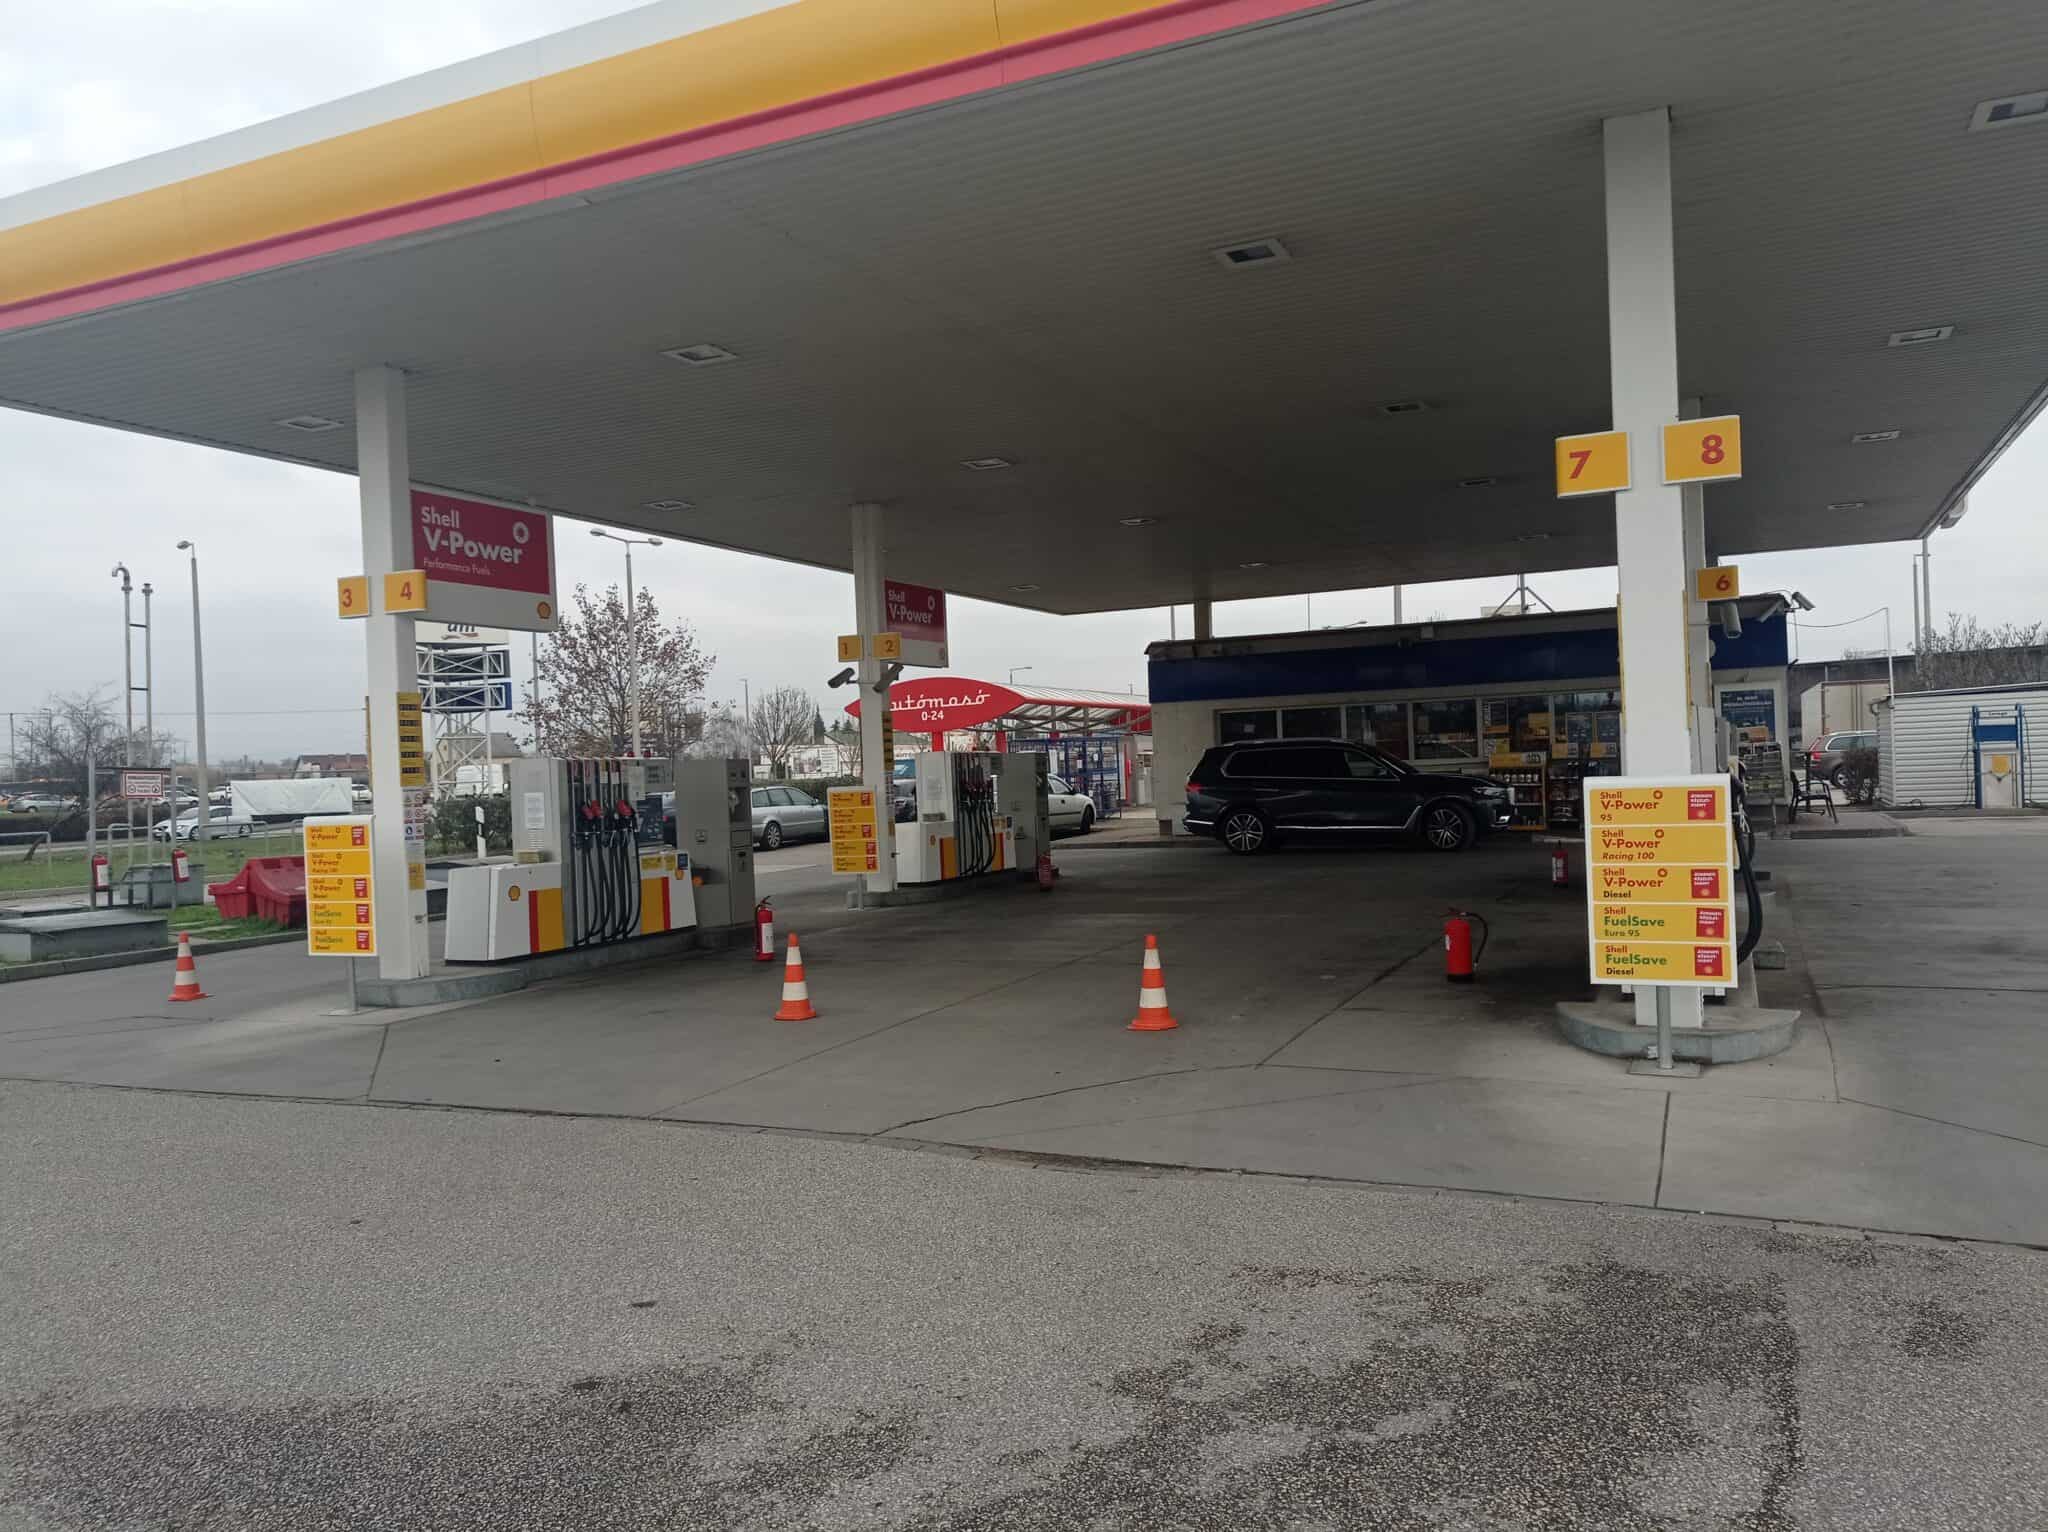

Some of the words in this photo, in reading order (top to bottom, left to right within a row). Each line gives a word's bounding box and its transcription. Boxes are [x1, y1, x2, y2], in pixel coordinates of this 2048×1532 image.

[1701, 434, 1724, 464] 8
[1569, 449, 1593, 480] 7
[421, 505, 460, 529] Shell
[422, 526, 523, 564] V-Power
[1716, 575, 1731, 592] 6
[400, 581, 413, 601] 4
[888, 590, 905, 603] Shell
[342, 588, 353, 608] 3
[888, 603, 933, 625] V-Power
[841, 642, 848, 656] 1
[885, 640, 895, 653] 2
[890, 689, 991, 712] utómosó
[921, 710, 945, 721] 0-24
[1600, 791, 1622, 800] Shell
[1601, 800, 1660, 810] V-Power
[1600, 814, 1613, 822] 95
[1601, 829, 1624, 838] Shell
[1602, 839, 1661, 849] V-Power
[1602, 852, 1634, 861] Racing
[1637, 851, 1655, 860] 100
[1603, 868, 1625, 877] Shell
[1604, 877, 1664, 888] V-Power
[1603, 890, 1632, 898] Diesel
[1604, 907, 1626, 915] Shell
[1604, 915, 1665, 927] FuelSave
[1604, 929, 1626, 937] Euro
[1627, 929, 1640, 937] 95
[1605, 945, 1628, 953] Shell
[1606, 954, 1668, 965] FuelSave
[1606, 967, 1634, 976] Diesel
